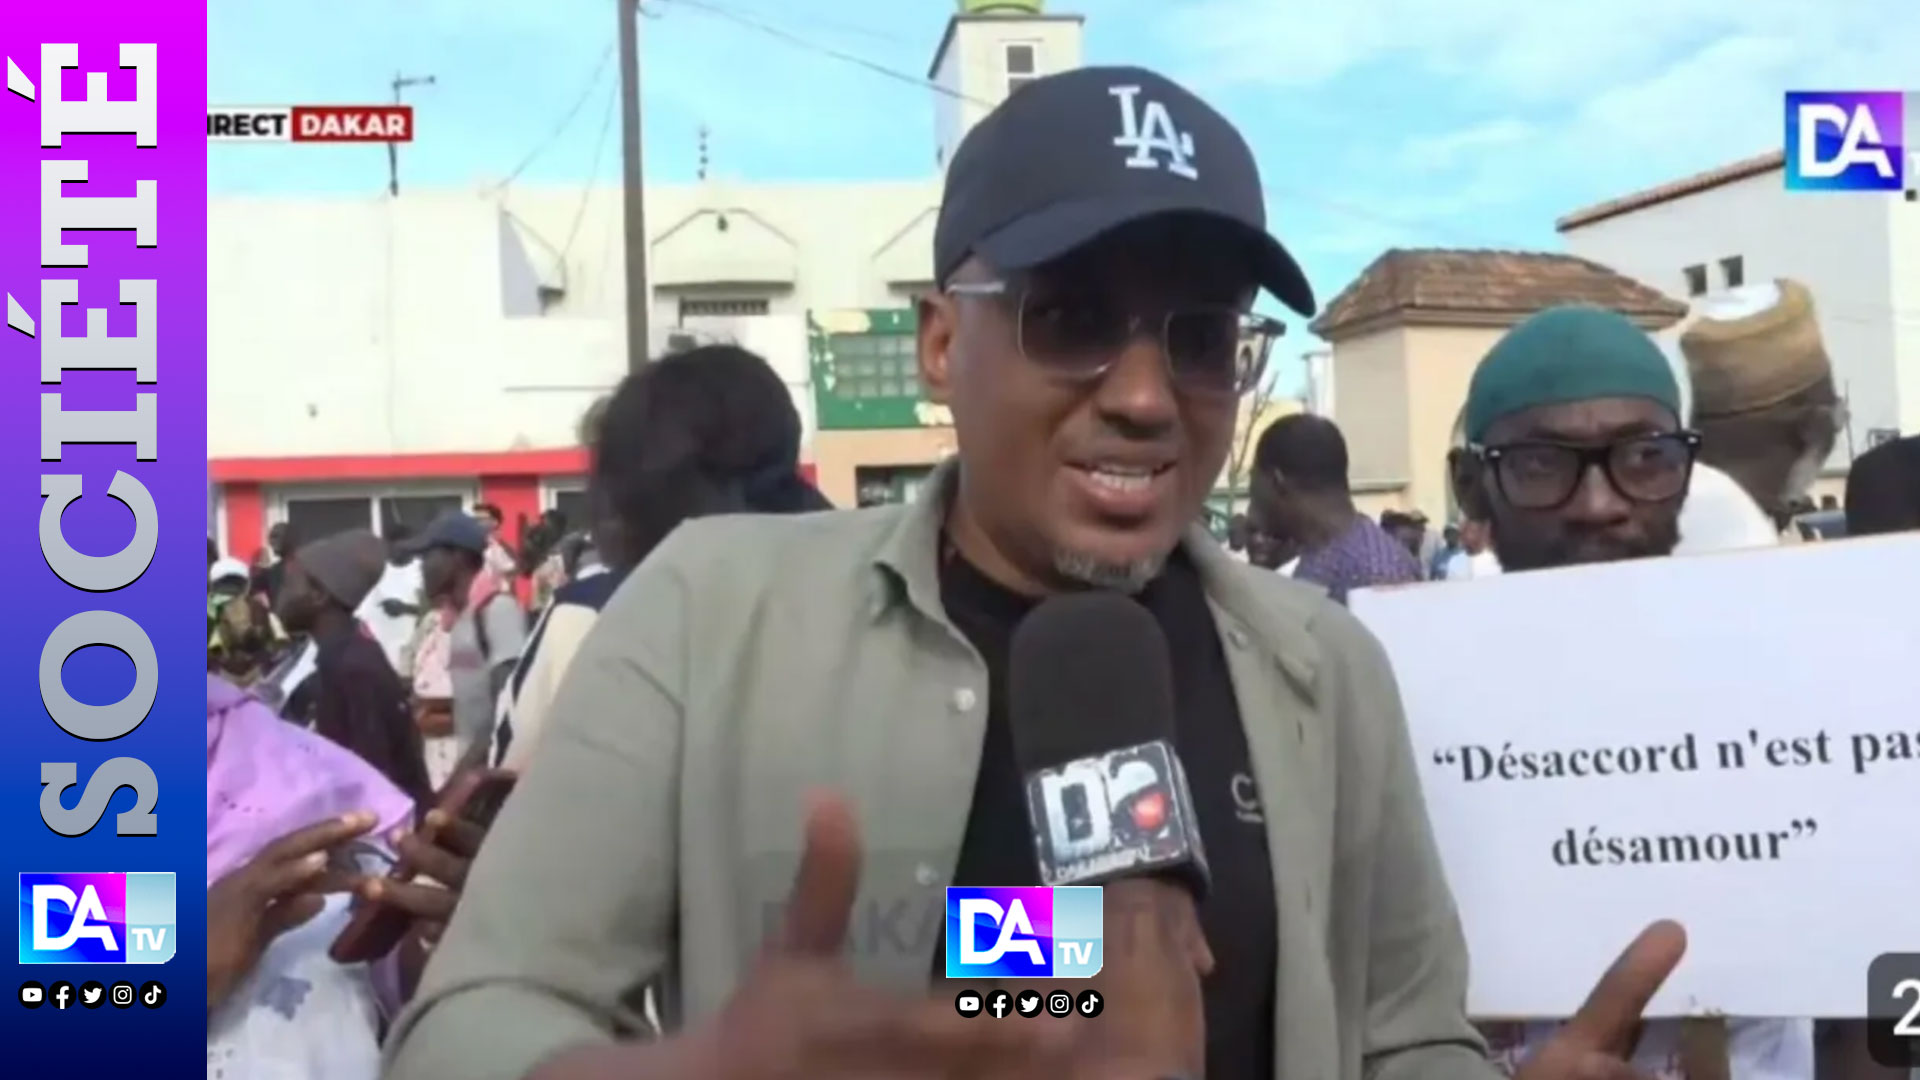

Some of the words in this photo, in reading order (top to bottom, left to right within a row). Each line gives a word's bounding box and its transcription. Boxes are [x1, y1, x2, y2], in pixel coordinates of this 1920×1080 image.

[1109, 85, 1198, 180] LA
[1717, 728, 1832, 769] n'est
[1851, 730, 1920, 774] pa
